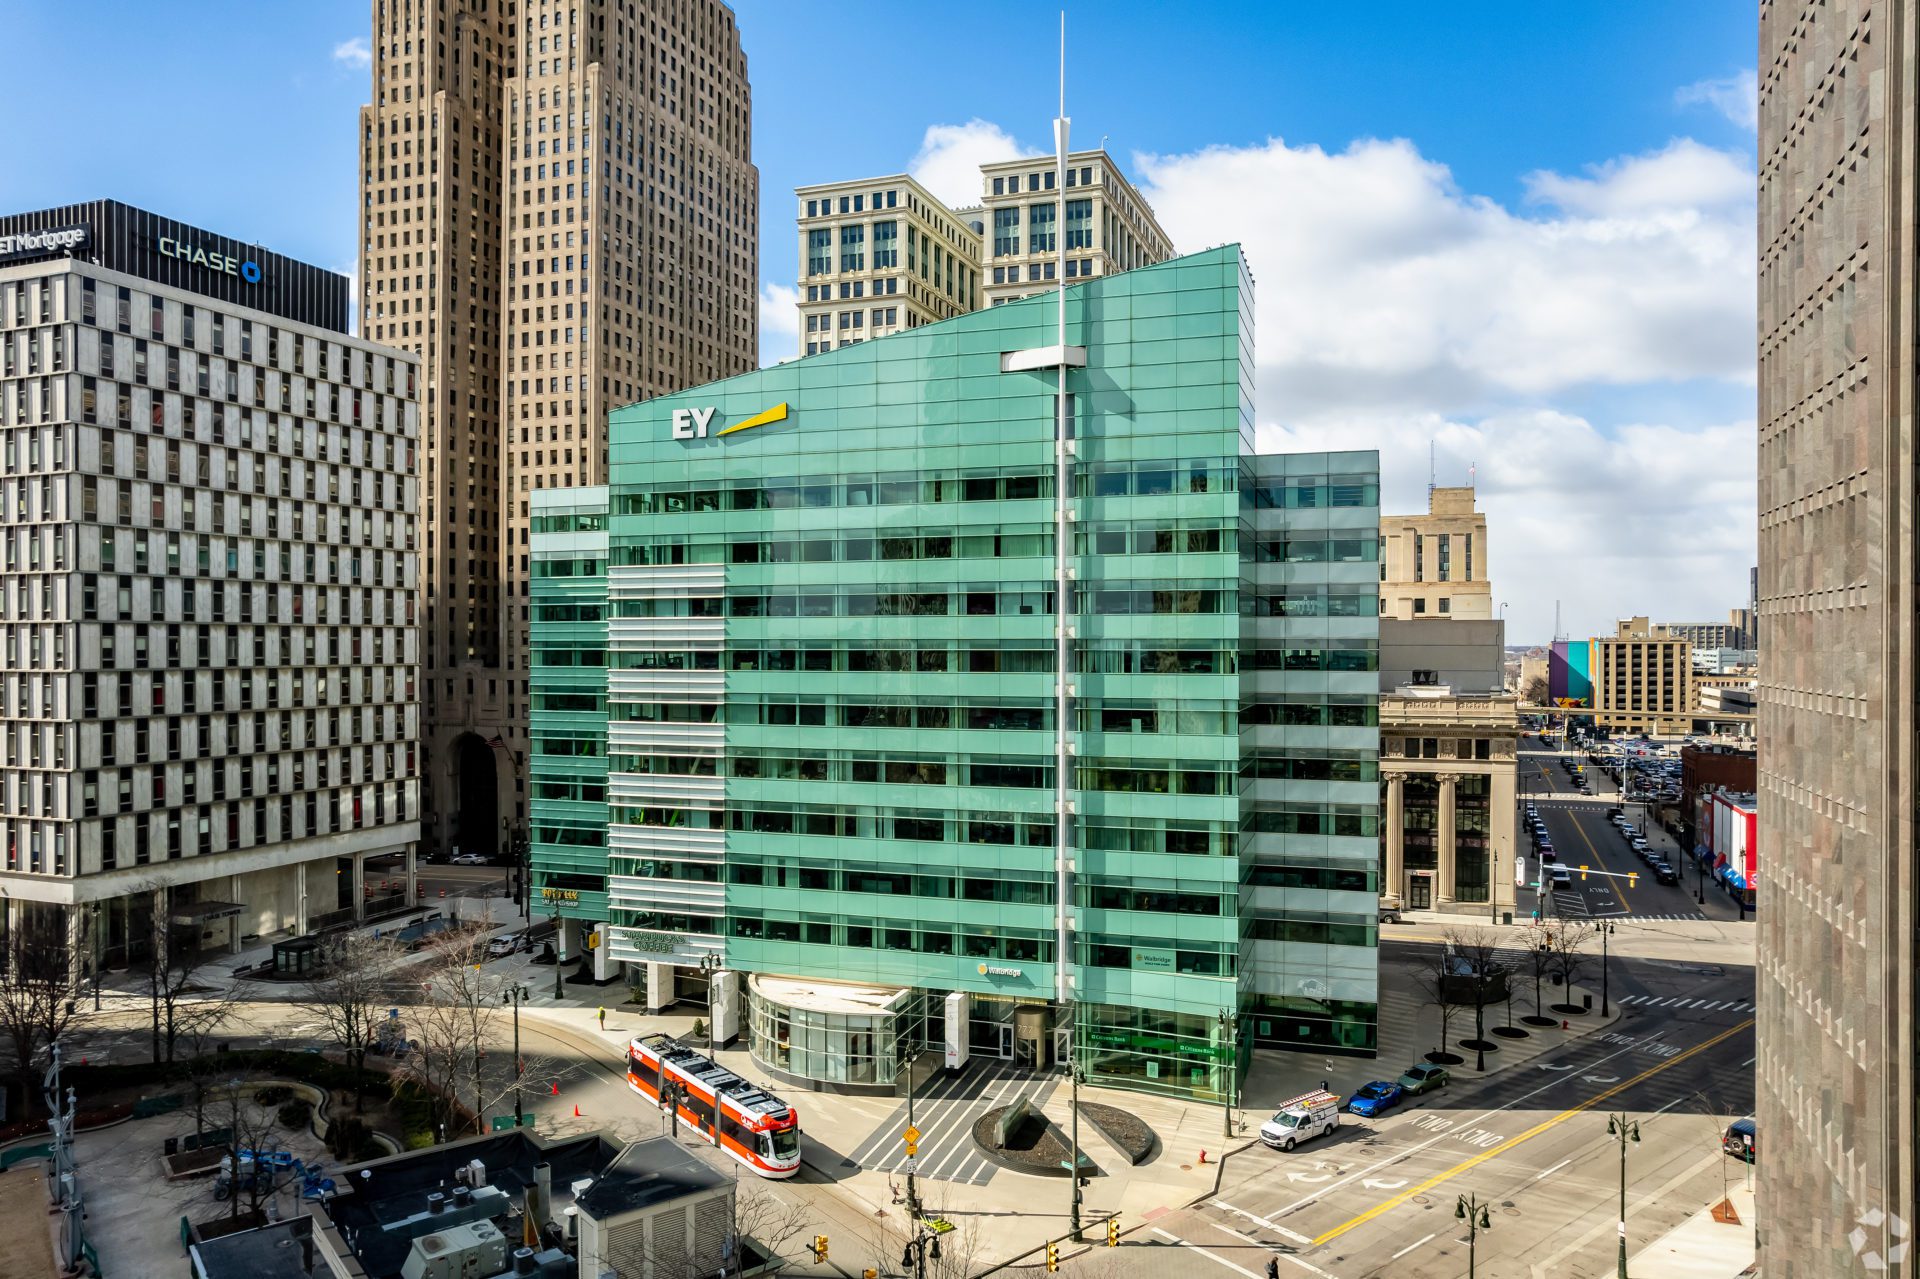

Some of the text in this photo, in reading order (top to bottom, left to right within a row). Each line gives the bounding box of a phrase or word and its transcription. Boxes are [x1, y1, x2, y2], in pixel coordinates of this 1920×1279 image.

[16, 228, 86, 251] Mortgage
[160, 237, 237, 276] CHASE
[672, 406, 716, 440] EY
[1627, 748, 1647, 756] FedEx
[222, 909, 241, 917] TOWER
[622, 930, 686, 944] STARBUCKS
[634, 941, 674, 954] COFFEE
[1144, 955, 1171, 963] Walbridge
[988, 966, 1021, 977] Walbridge
[1018, 1024, 1033, 1034] 777
[1591, 1032, 1635, 1045] ONLY
[1637, 1042, 1682, 1057] ONLY
[1406, 1113, 1454, 1132] ONLY
[1453, 1128, 1505, 1147] ONLY
